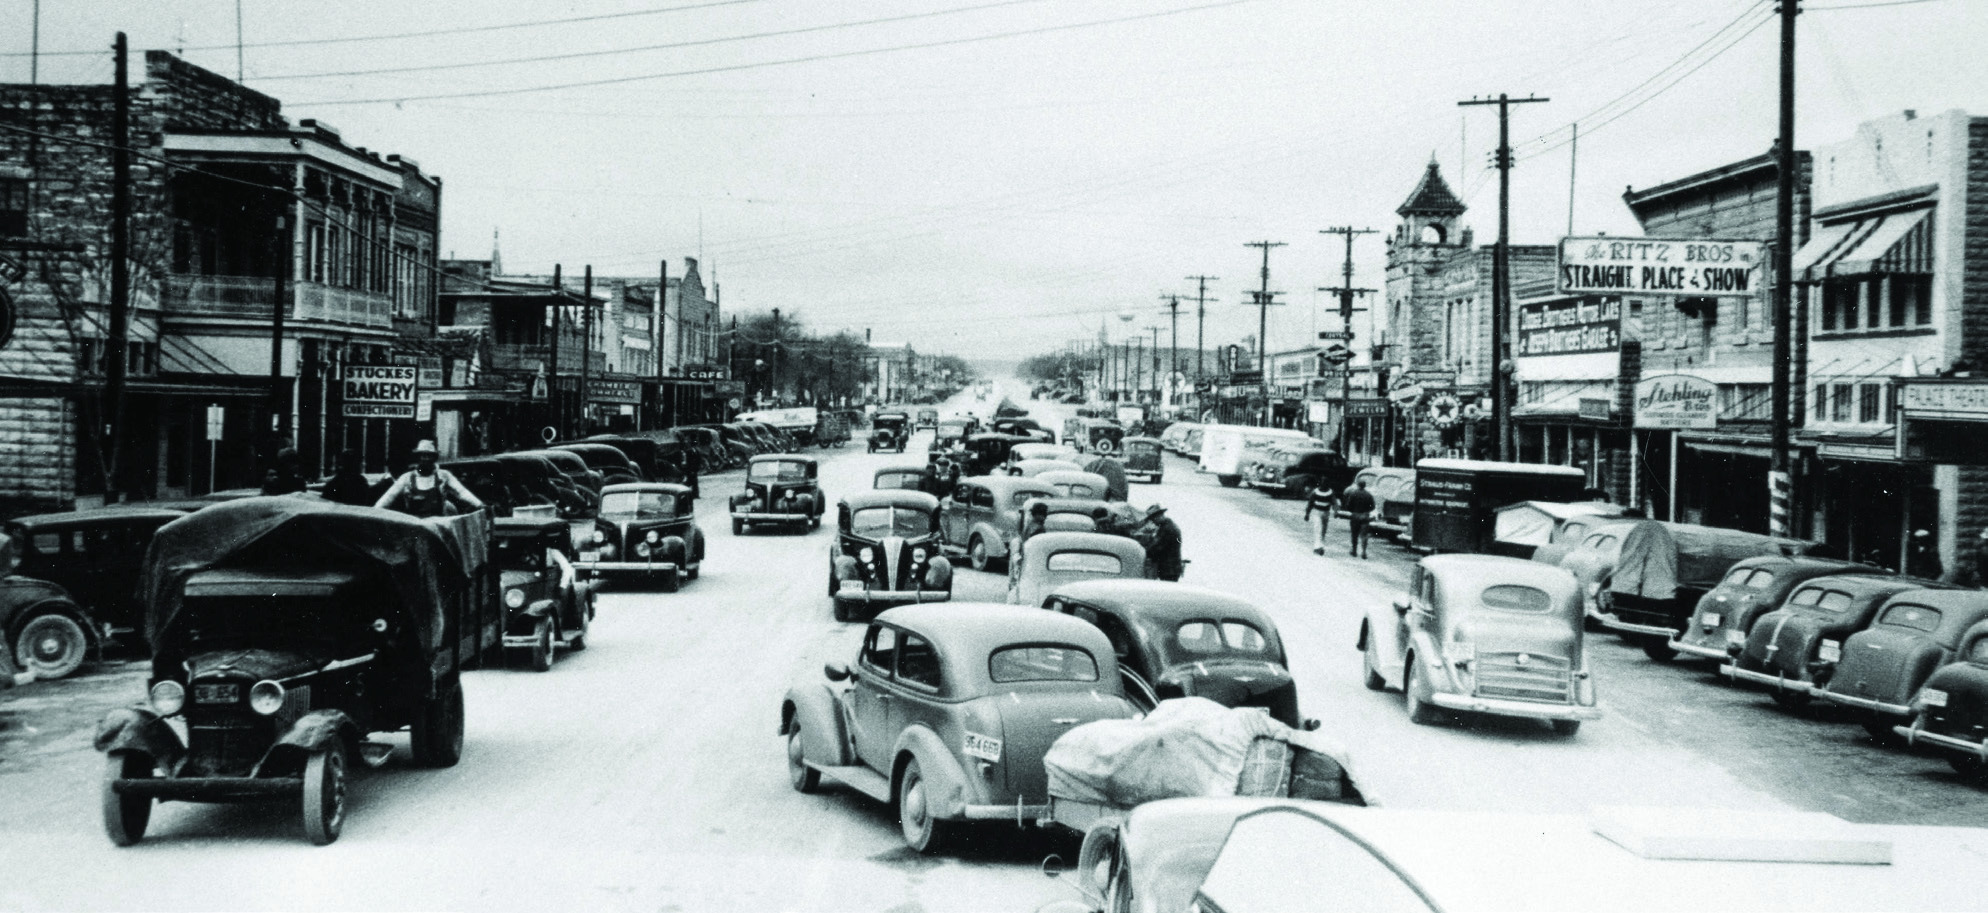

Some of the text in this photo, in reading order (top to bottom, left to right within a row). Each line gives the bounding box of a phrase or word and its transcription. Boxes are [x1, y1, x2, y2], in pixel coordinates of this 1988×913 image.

[1609, 242, 1670, 262] RITZ
[1685, 244, 1733, 262] BROS
[1642, 266, 1685, 289] PLACE
[1703, 267, 1752, 291] SHOW
[346, 367, 414, 379] STUCKES
[689, 371, 724, 379] CAFE
[345, 381, 414, 400] BAKERY
[1638, 381, 1714, 410] Stehling
